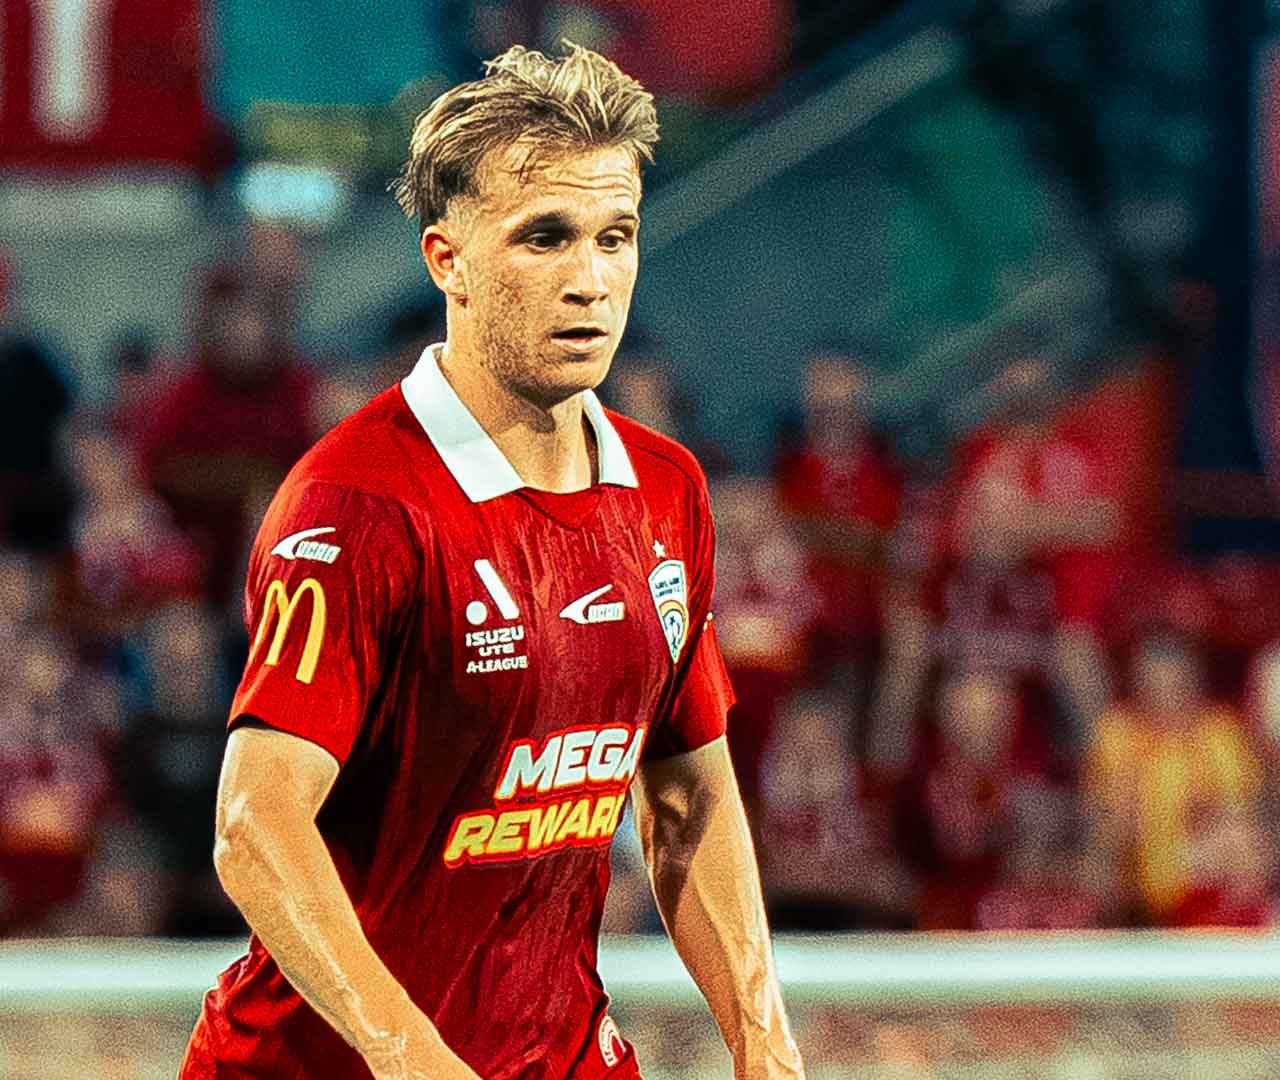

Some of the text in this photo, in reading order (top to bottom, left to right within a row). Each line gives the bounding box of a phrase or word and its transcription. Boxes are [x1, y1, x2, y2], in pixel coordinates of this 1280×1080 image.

[465, 625, 524, 647] ISUZU
[478, 642, 515, 657] UTE
[466, 655, 528, 674] A-LEAGUE
[443, 794, 625, 861] REWAR
